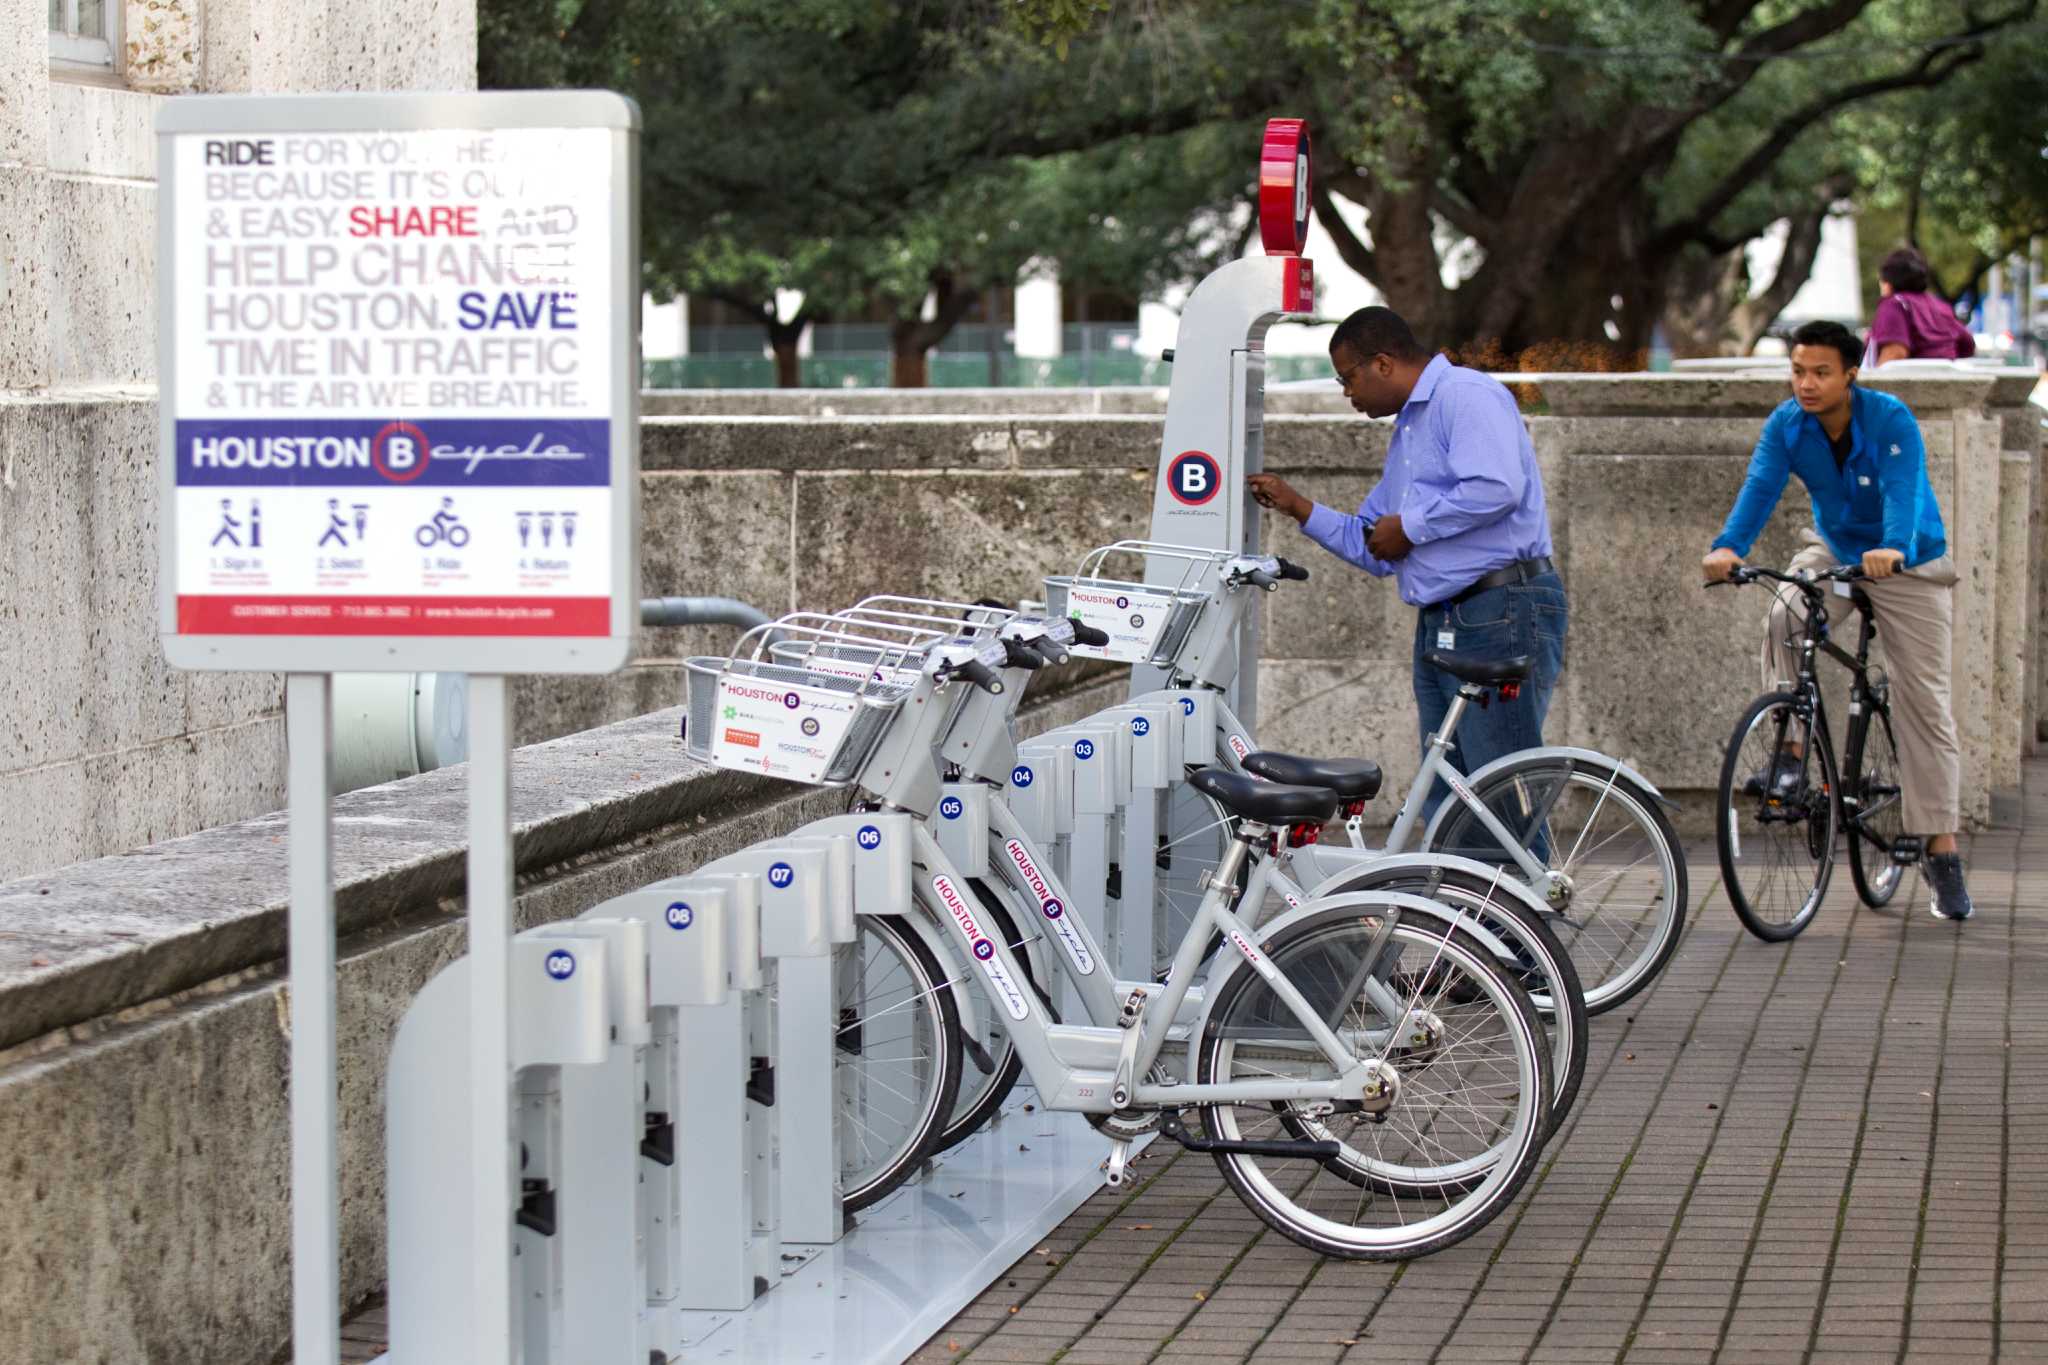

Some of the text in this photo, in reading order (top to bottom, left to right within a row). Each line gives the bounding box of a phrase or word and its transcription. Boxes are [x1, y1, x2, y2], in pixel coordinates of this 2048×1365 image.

[205, 140, 275, 166] RIDE
[285, 139, 348, 165] FOR
[206, 170, 375, 202] BECAUSE
[206, 207, 231, 239] &
[241, 207, 340, 239] EASY.
[500, 204, 578, 236] AND
[206, 245, 339, 287] HELP
[206, 291, 578, 331] HOUSTON. SAVE
[207, 337, 579, 376] TIME IN TRAFFIC
[206, 381, 588, 409] & THE AIR WE BREATHE.
[191, 433, 587, 475] HOUSTON B cycle
[1182, 463, 1207, 492] B
[223, 556, 249, 572] Sign
[330, 556, 365, 570] Select
[532, 557, 571, 570] Return
[1074, 593, 1116, 606] HOUSTON
[727, 685, 783, 703] HOUSTON
[1132, 720, 1148, 733] 02
[1075, 743, 1092, 756] 03
[1014, 770, 1030, 783] 04
[942, 802, 960, 815] 05
[859, 831, 878, 845] 06
[771, 868, 790, 882] 07
[1008, 842, 1050, 900] HOUSTON
[668, 909, 689, 923] 08
[936, 879, 980, 940] HOUSTON
[549, 957, 572, 973] 09
